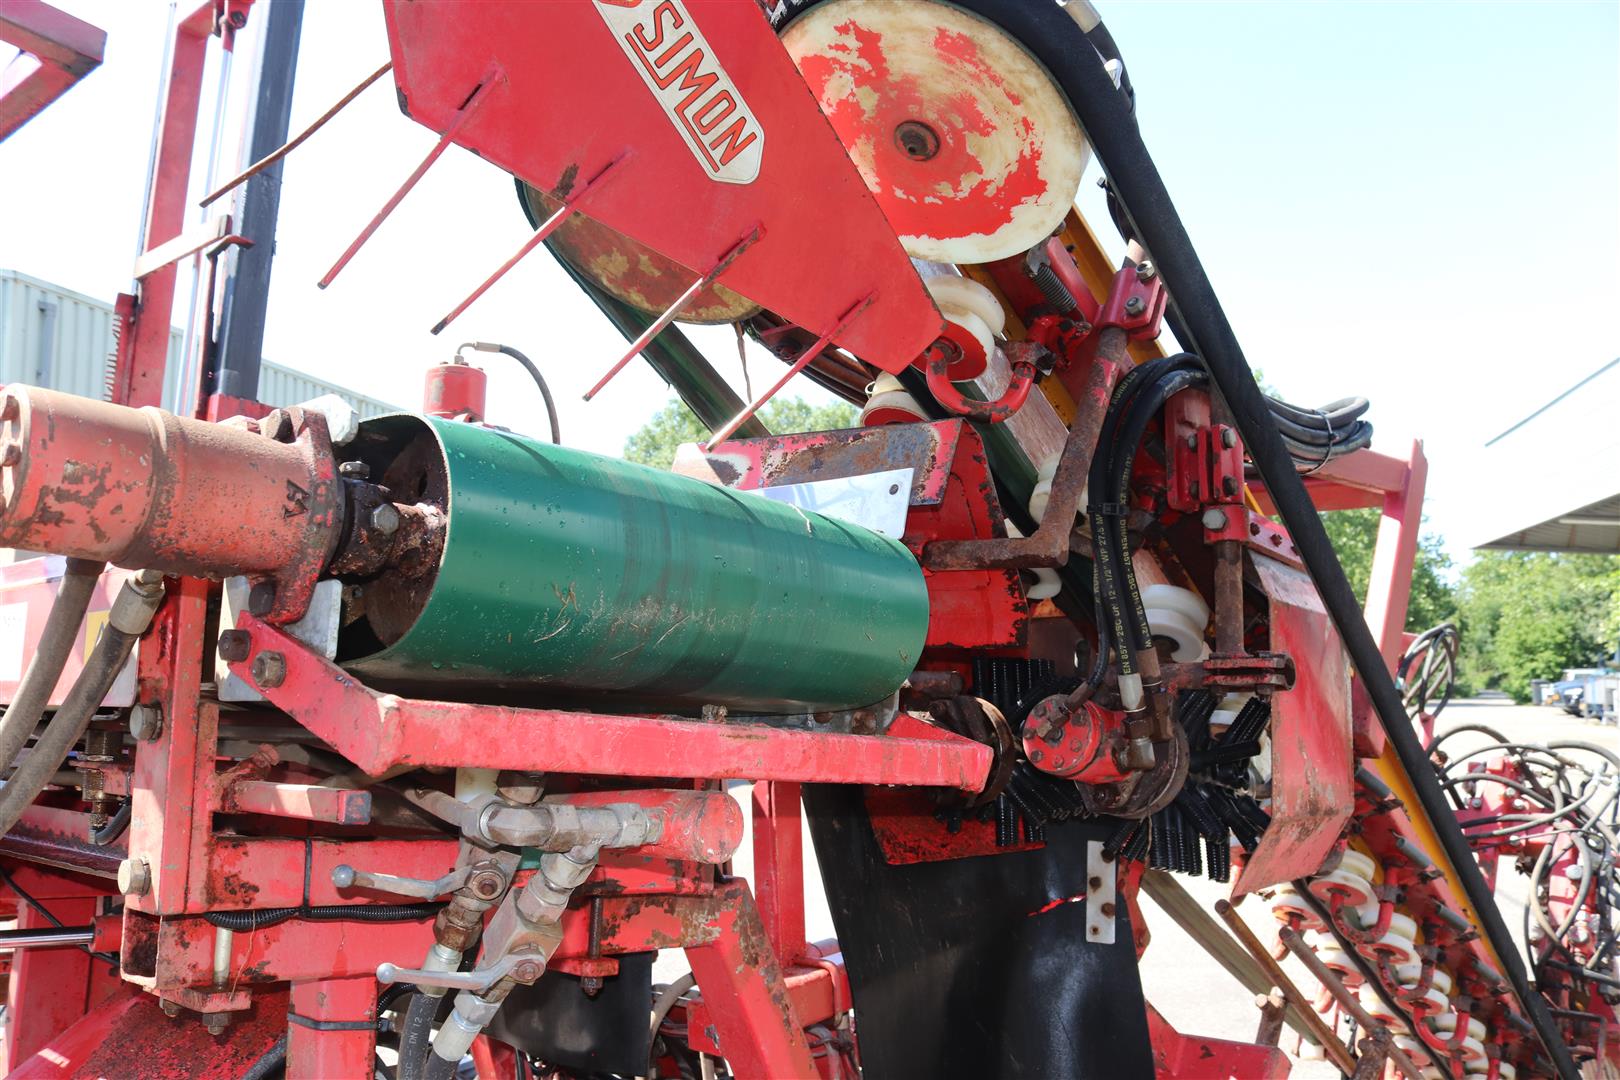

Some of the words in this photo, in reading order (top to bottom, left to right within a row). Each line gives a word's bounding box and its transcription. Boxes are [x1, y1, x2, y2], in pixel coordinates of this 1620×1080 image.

[631, 0, 758, 173] SIMON
[1100, 547, 1109, 563] WP
[1123, 551, 1131, 566] 857
[1108, 589, 1116, 600] 12
[1115, 619, 1125, 637] 2SC
[1120, 645, 1130, 660] 857
[1122, 661, 1132, 674] EN
[413, 1016, 423, 1027] 12
[409, 1032, 418, 1044] DN
